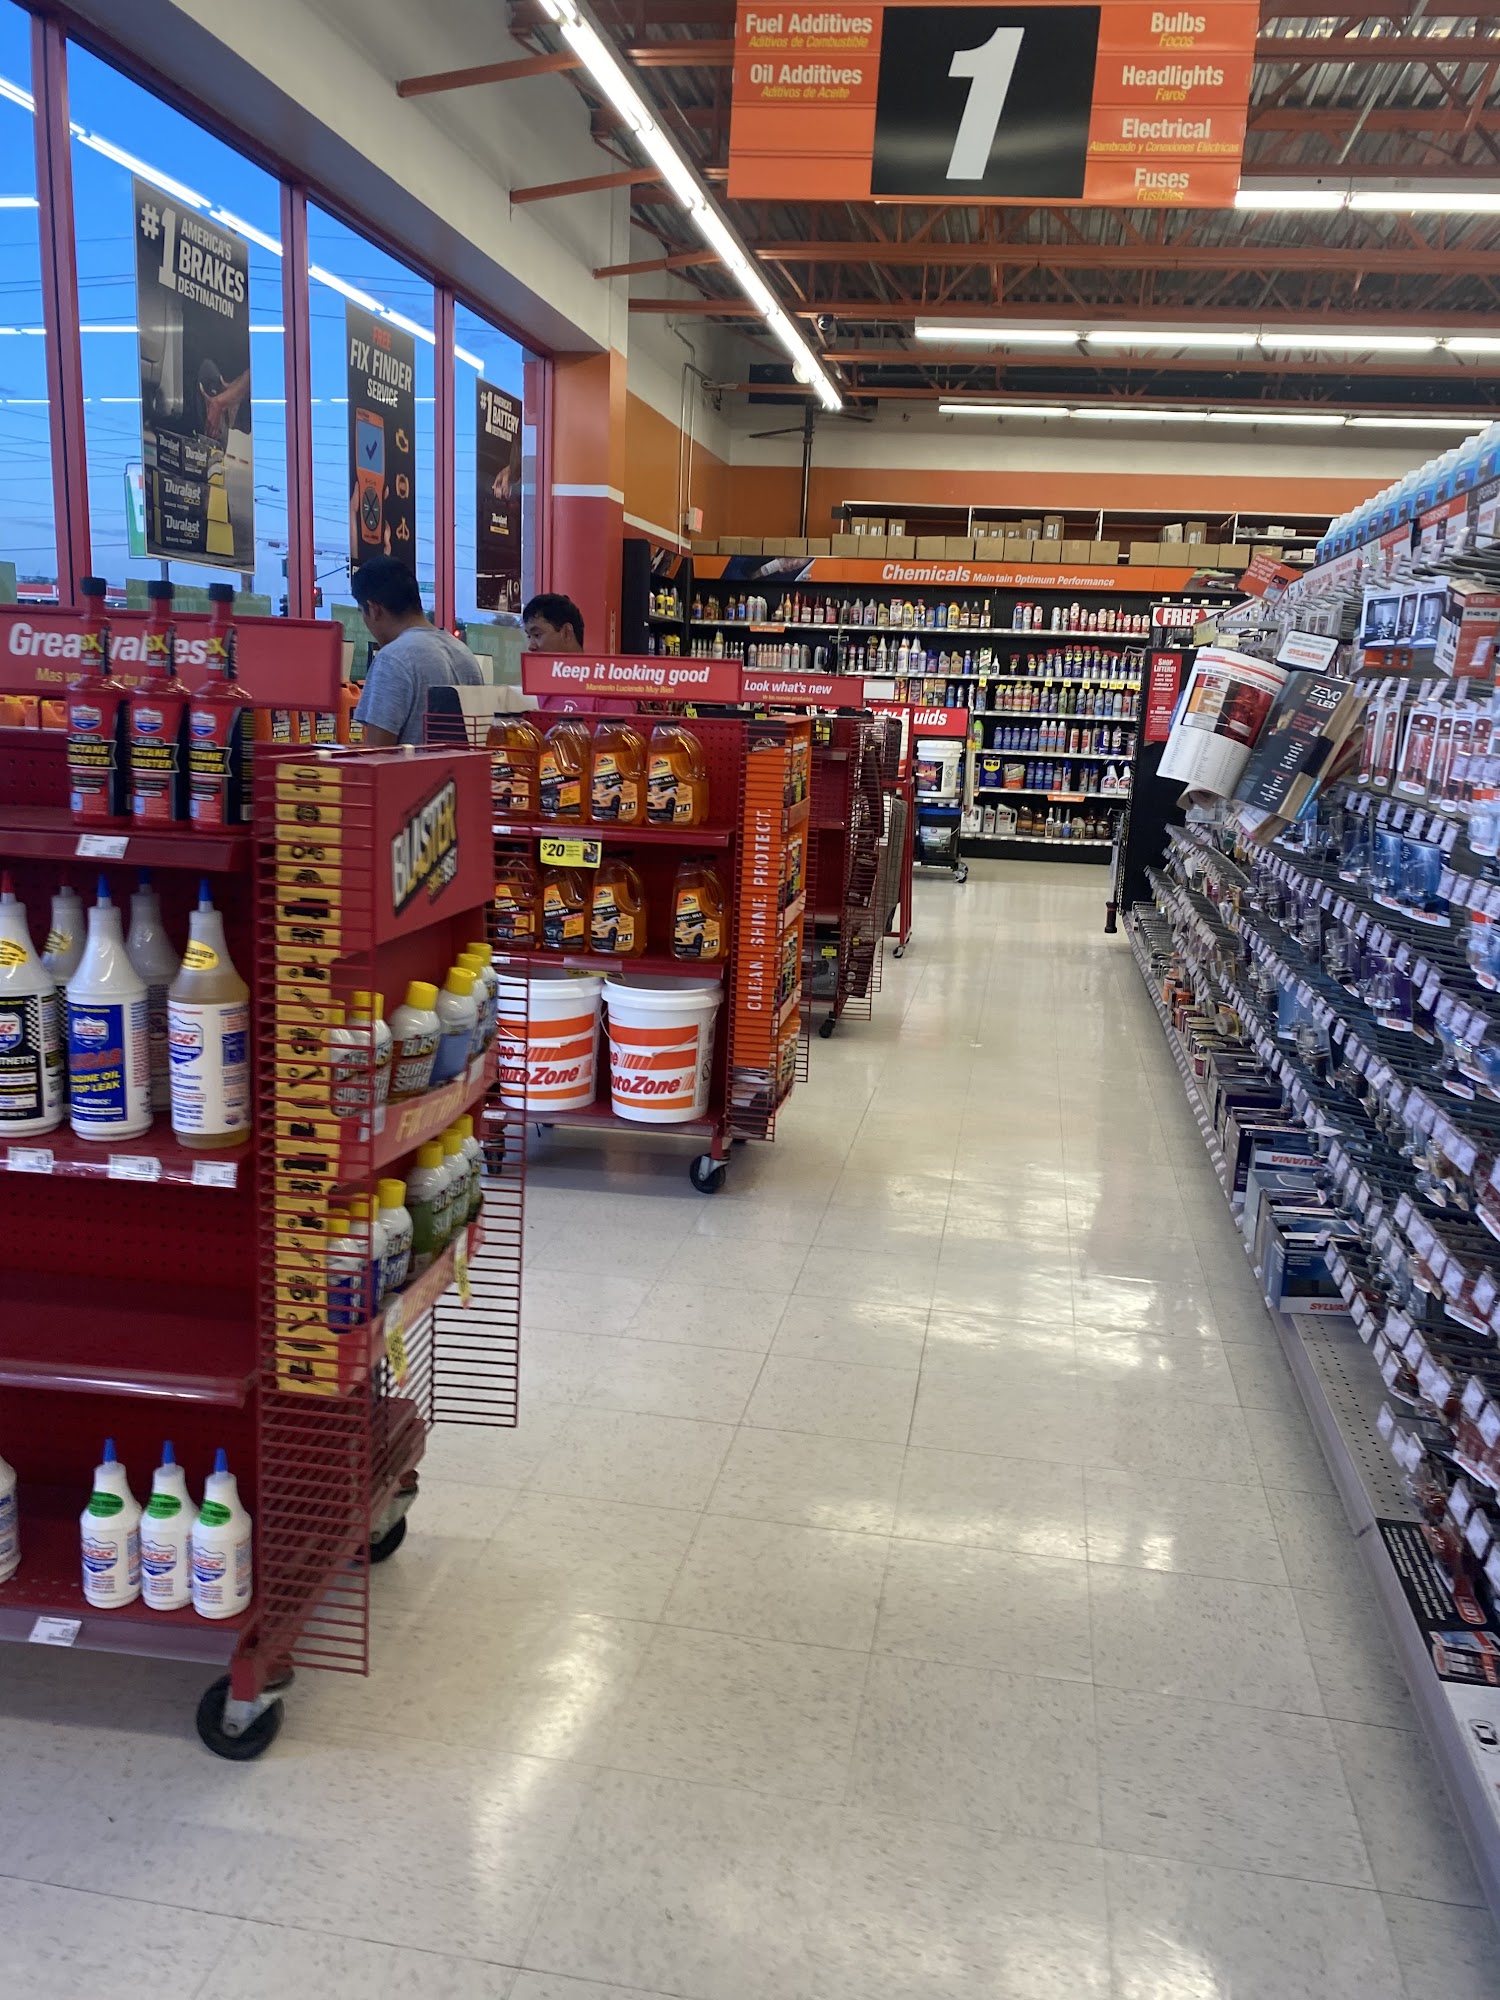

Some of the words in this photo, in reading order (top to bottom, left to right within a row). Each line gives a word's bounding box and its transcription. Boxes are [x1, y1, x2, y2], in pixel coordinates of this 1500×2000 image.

[745, 13, 783, 33] Fuel
[788, 13, 873, 34] Additives
[1150, 12, 1206, 33] Bulbs
[791, 36, 804, 48] de
[1159, 33, 1195, 47] Focos
[750, 64, 774, 84] Oil
[778, 64, 863, 85] Additives
[1121, 65, 1225, 90] Headlights
[760, 86, 801, 98] Aditivos
[803, 86, 817, 98] de
[817, 87, 850, 99] Aceite
[945, 26, 1025, 180] 1
[1155, 88, 1187, 101] Faros
[1121, 118, 1212, 139] Electrical
[1138, 144, 1143, 153] y
[1145, 142, 1195, 152] Conexiones
[1134, 168, 1190, 188] Fuses
[1136, 188, 1185, 201] Fusibles
[181, 217, 232, 261] AMERICA'S
[178, 239, 245, 303] BRAKES
[177, 276, 234, 319] DESTINATION
[350, 338, 370, 373] FIX
[372, 349, 413, 393] FINDER
[366, 378, 398, 408] SERVICE
[492, 406, 519, 434] BATTERY
[164, 478, 201, 500] Duralast
[164, 515, 200, 533] Duralast
[882, 564, 971, 582] Chemicals
[1014, 574, 1055, 586] Optimum
[1057, 576, 1115, 587] Performance
[1162, 608, 1200, 627] FREE
[9, 622, 82, 659] Grea
[110, 629, 207, 665] vales
[35, 668, 63, 683] Mas
[552, 661, 590, 683] Keep
[593, 663, 606, 679] it
[608, 663, 664, 686] looking
[668, 666, 710, 686] good
[744, 679, 770, 692] Look
[771, 681, 806, 693] what's
[808, 684, 833, 695] new
[1311, 685, 1342, 702] ZEVO
[1317, 699, 1337, 709] LED
[901, 708, 948, 726] Fuids
[542, 843, 565, 857] $20
[753, 808, 772, 886] PROTECT.
[101, 1071, 121, 1081] OIL
[500, 1063, 581, 1086] AutoZone
[91, 1081, 120, 1093] LEAK
